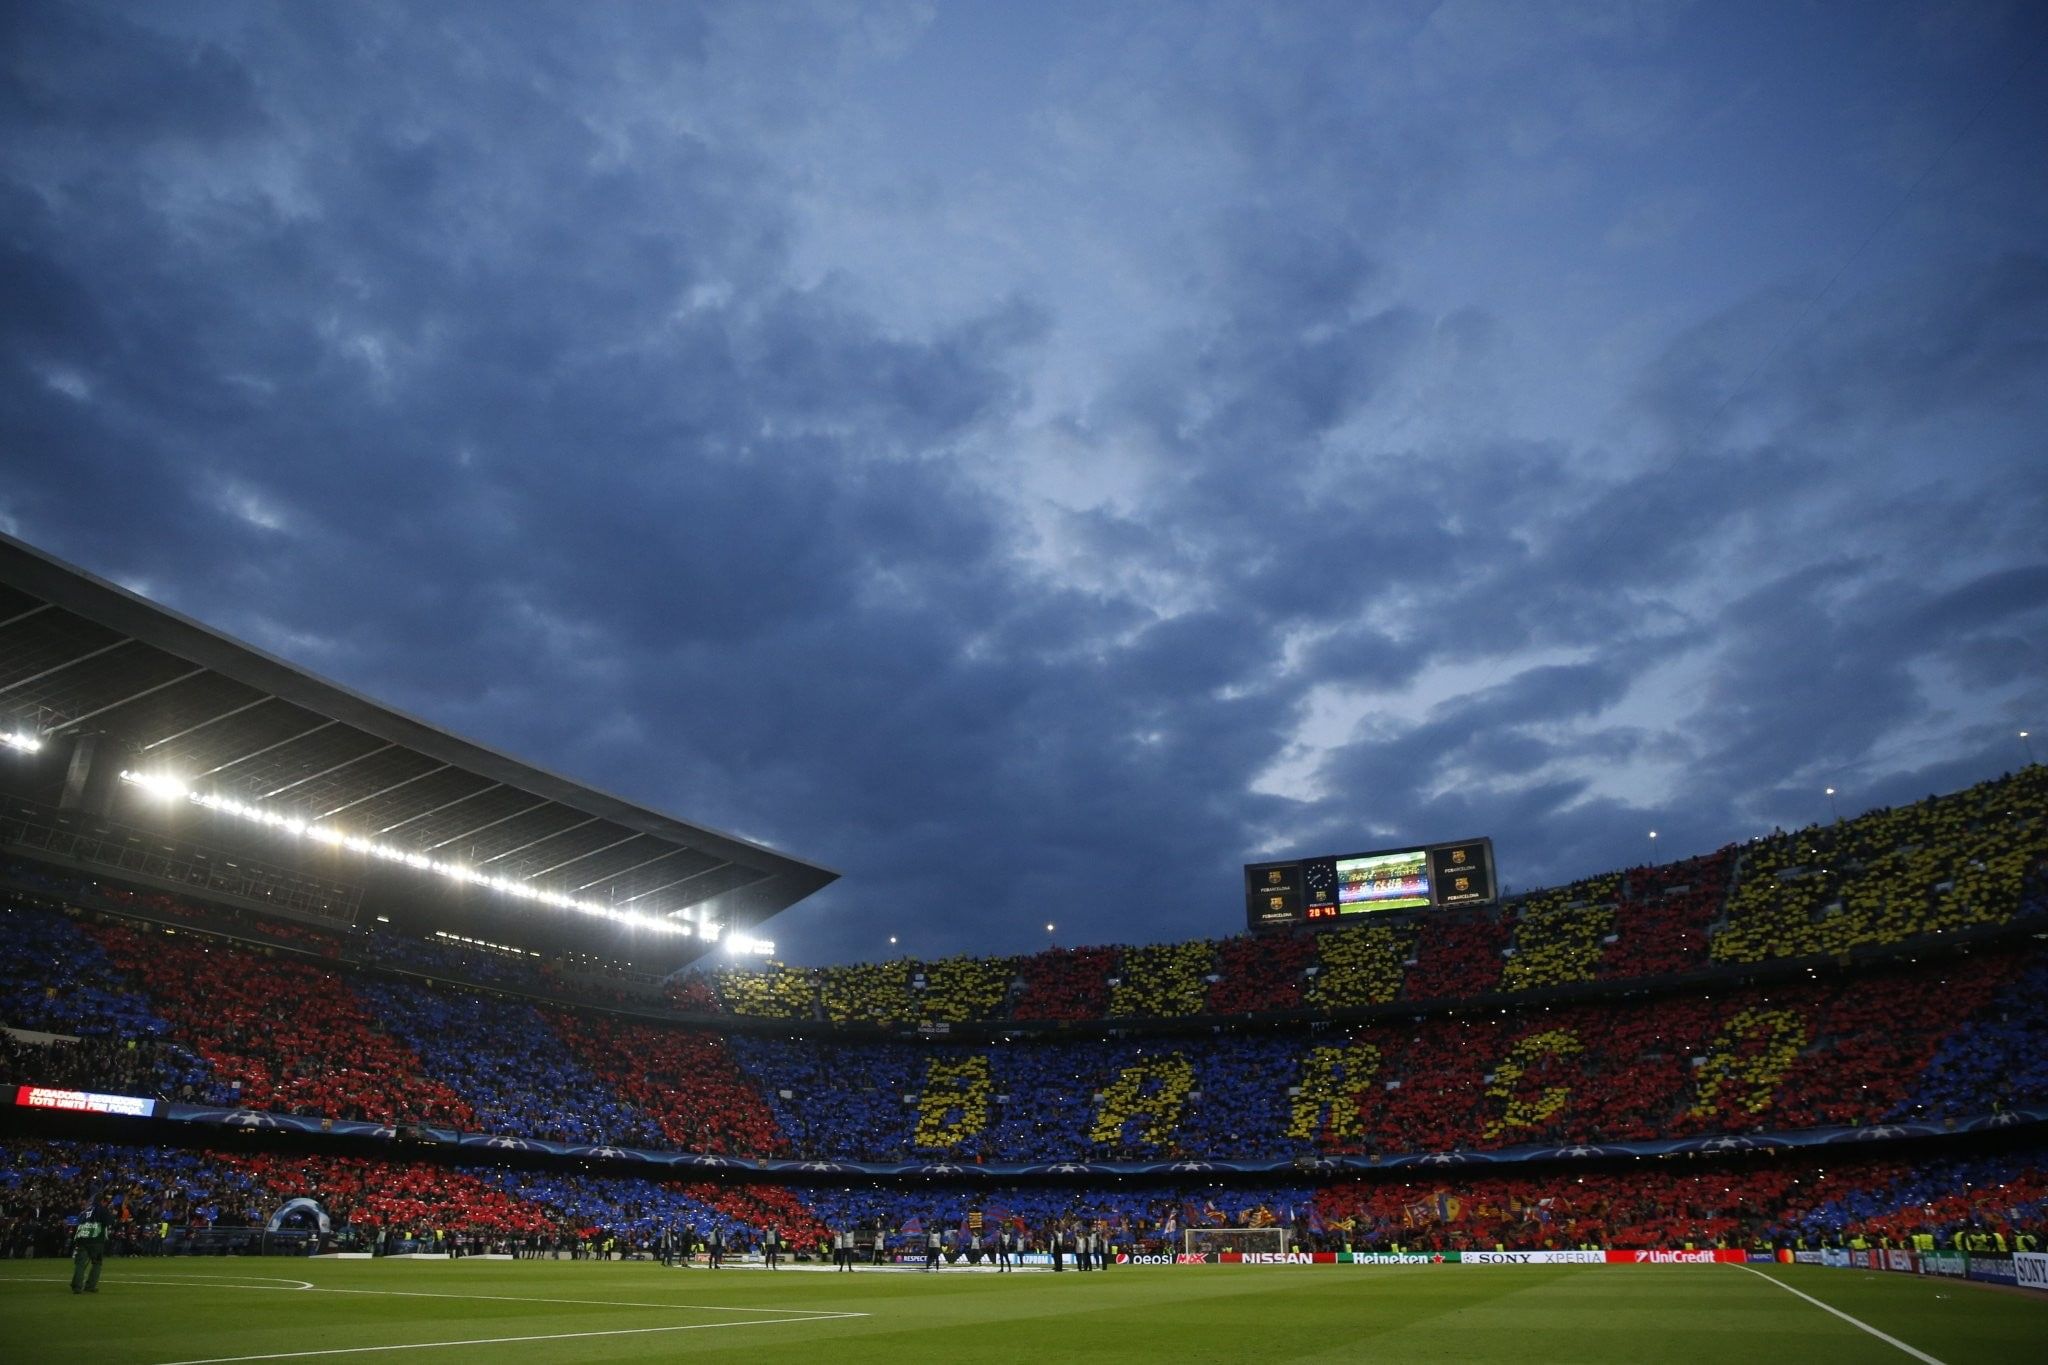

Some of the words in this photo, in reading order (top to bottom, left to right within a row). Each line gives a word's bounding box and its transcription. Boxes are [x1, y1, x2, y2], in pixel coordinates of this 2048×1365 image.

[1242, 1253, 1313, 1264] NISSAN
[1352, 1253, 1428, 1264] Heineken
[1479, 1254, 1531, 1263] SONY
[1545, 1253, 1601, 1263] XPERIA
[1651, 1250, 1715, 1263] UniCredit
[2017, 1258, 2048, 1283] SONY
